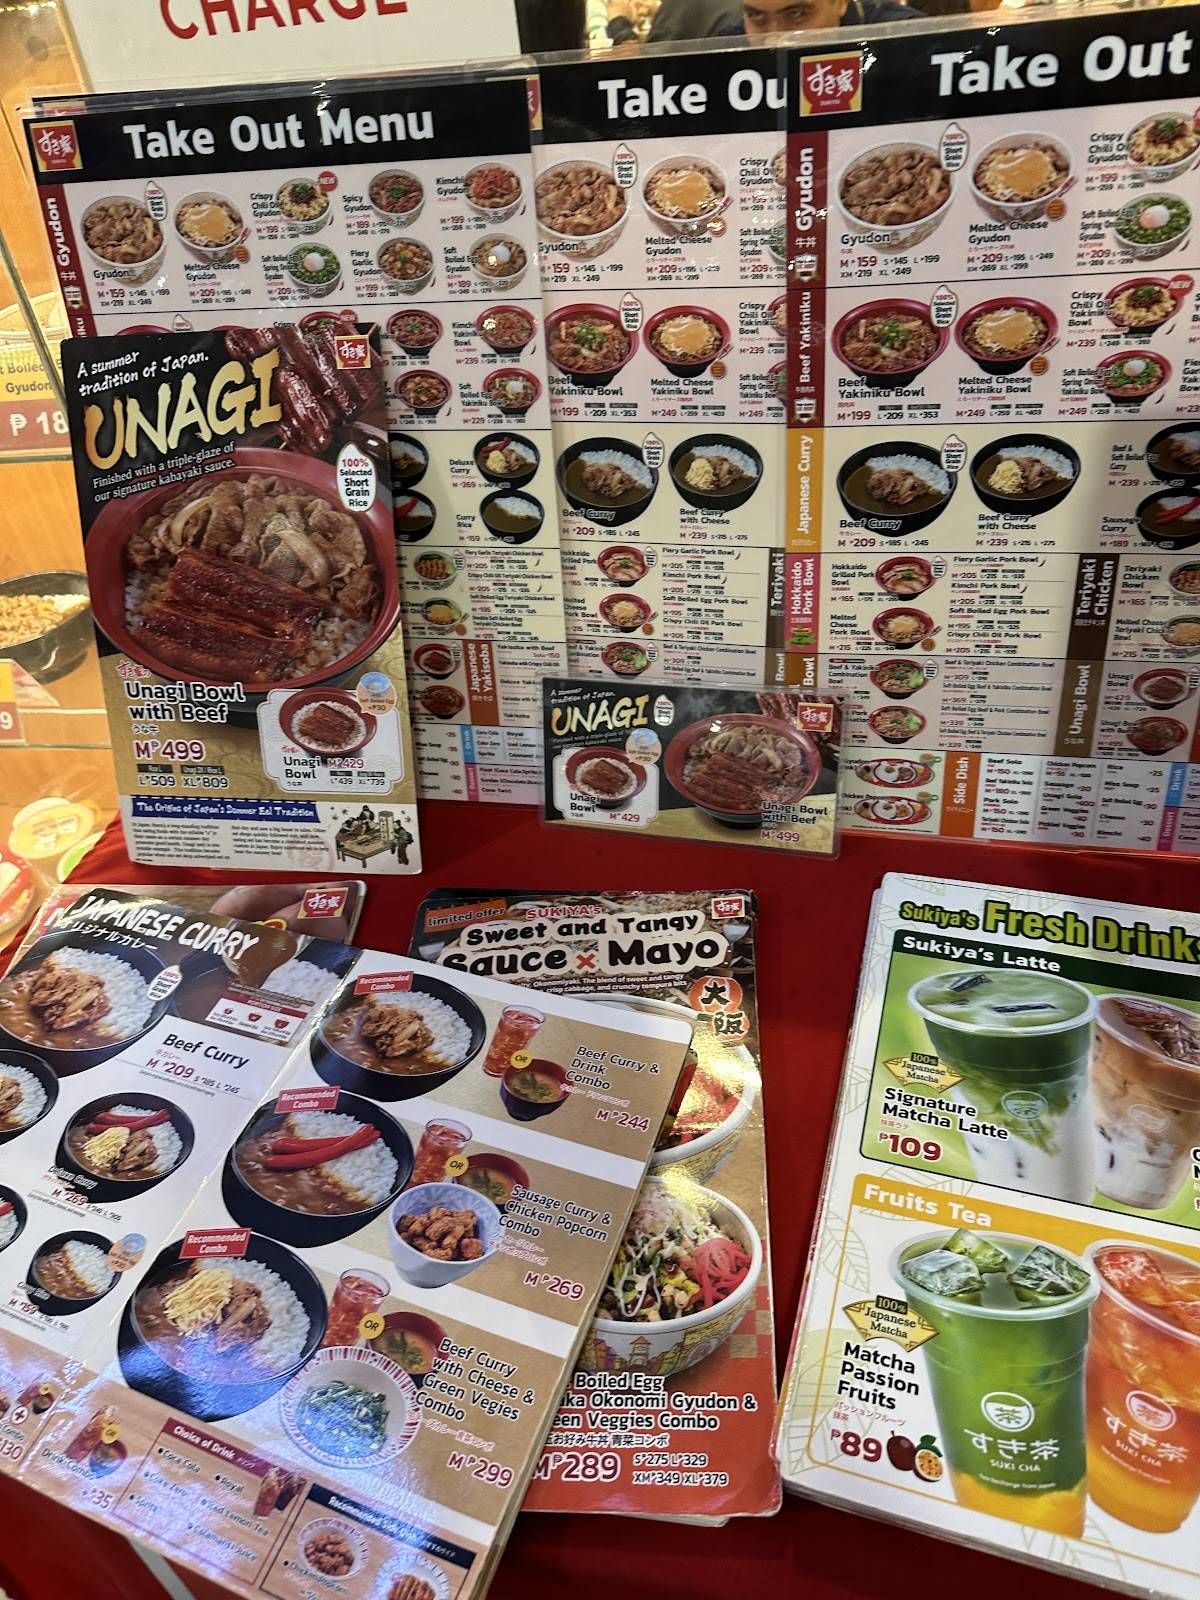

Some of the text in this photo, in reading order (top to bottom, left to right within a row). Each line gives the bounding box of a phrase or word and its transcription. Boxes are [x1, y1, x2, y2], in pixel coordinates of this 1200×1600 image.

[160, 0, 408, 39] CHAR
[931, 30, 1192, 96] Take Out
[598, 75, 708, 119] Take
[122, 107, 434, 159] Take Out Menu
[795, 147, 814, 231] Gyudon
[48, 198, 70, 267] Gyudon
[841, 232, 890, 246] Gyudon
[968, 234, 1011, 244] Gyudon
[969, 221, 1048, 232] Melted Cheese
[93, 269, 129, 280] Gyudon
[800, 292, 811, 382] Beef Yakiniku
[77, 351, 140, 378] A summer
[78, 351, 209, 396] tradition of Japan.
[838, 377, 866, 387] Beef
[838, 387, 925, 398] Yakiniku Bowl
[84, 348, 283, 470] UNAGI
[93, 470, 132, 489] Finished
[134, 463, 156, 478] with
[167, 448, 221, 470] triple-glaze
[224, 441, 236, 454] of
[341, 456, 369, 468] 100%
[94, 458, 235, 502] our signature kabayaki sauce.
[345, 477, 369, 488] Short
[345, 487, 370, 497] Grain
[797, 435, 815, 534] Japanese Curry
[349, 499, 368, 507] Rice
[562, 509, 615, 520] Beef Curry
[840, 518, 900, 530] Beef Curry
[978, 522, 1036, 531] with Cheese
[1002, 514, 1029, 523] Curry
[790, 561, 803, 615] Hokkaido
[802, 559, 814, 615] Pork Bowl
[1075, 559, 1097, 615] Teriyaki
[1093, 560, 1113, 616] Chicken
[125, 681, 246, 704] Unagi Bowl
[1069, 665, 1091, 735] Unagi Bowl
[128, 701, 228, 722] with Beef
[551, 694, 649, 736] UNAGI
[283, 756, 321, 769] Unagi
[286, 769, 317, 779] Bowl
[136, 803, 153, 811] The
[155, 803, 181, 813] Origins
[183, 804, 192, 813] of
[274, 807, 314, 817] Tradition
[570, 793, 600, 803] Unagi
[570, 803, 596, 813] Bowl
[762, 801, 828, 816] Unagi Bowl
[762, 813, 817, 825] with Beef
[72, 896, 260, 960] JAPANESE CURRY
[427, 907, 505, 928] limited offer
[466, 914, 699, 946] Sweet and Tangy
[900, 900, 1200, 965] Sukiya's Fresh Drink
[442, 937, 720, 976] Sauce Mayo
[902, 935, 1062, 972] Sukiya's Latte
[358, 974, 411, 986] Recommended
[370, 982, 395, 991] Combo
[163, 1034, 250, 1069] Beef Curry
[576, 1045, 660, 1074] Beef Curry &
[565, 1070, 611, 1091] Combo
[570, 1058, 606, 1076] Drink
[884, 1087, 977, 1117] Signature
[882, 1103, 1009, 1141] Matcha Latte
[511, 1185, 611, 1225] Sausage Curry &
[863, 1185, 993, 1228] Fruits Tea
[499, 1214, 541, 1238] Combo
[504, 1198, 608, 1242] Chicken Popcorn
[186, 1231, 247, 1245] Recommended
[199, 1243, 229, 1254] Combo
[864, 1306, 917, 1329] Japanese
[876, 1297, 908, 1314] 100%
[870, 1321, 908, 1340] Matcha
[439, 1338, 517, 1377] Beef Curry
[843, 1341, 916, 1375] Matcha
[432, 1358, 535, 1405] with Cheese &
[575, 1374, 664, 1391] Boiled Egg
[841, 1361, 920, 1397] Passion
[415, 1391, 466, 1421] Combo
[423, 1374, 520, 1421] Green Vegies
[591, 1394, 666, 1408] Okonomi
[671, 1395, 738, 1412] Gyudon
[744, 1395, 756, 1409] &
[837, 1381, 897, 1410] Fruits
[588, 1413, 653, 1430] Veggies
[659, 1414, 718, 1429] Combo
[964, 1429, 1060, 1460] すき茶
[990, 1459, 1041, 1472] SUKI CHA
